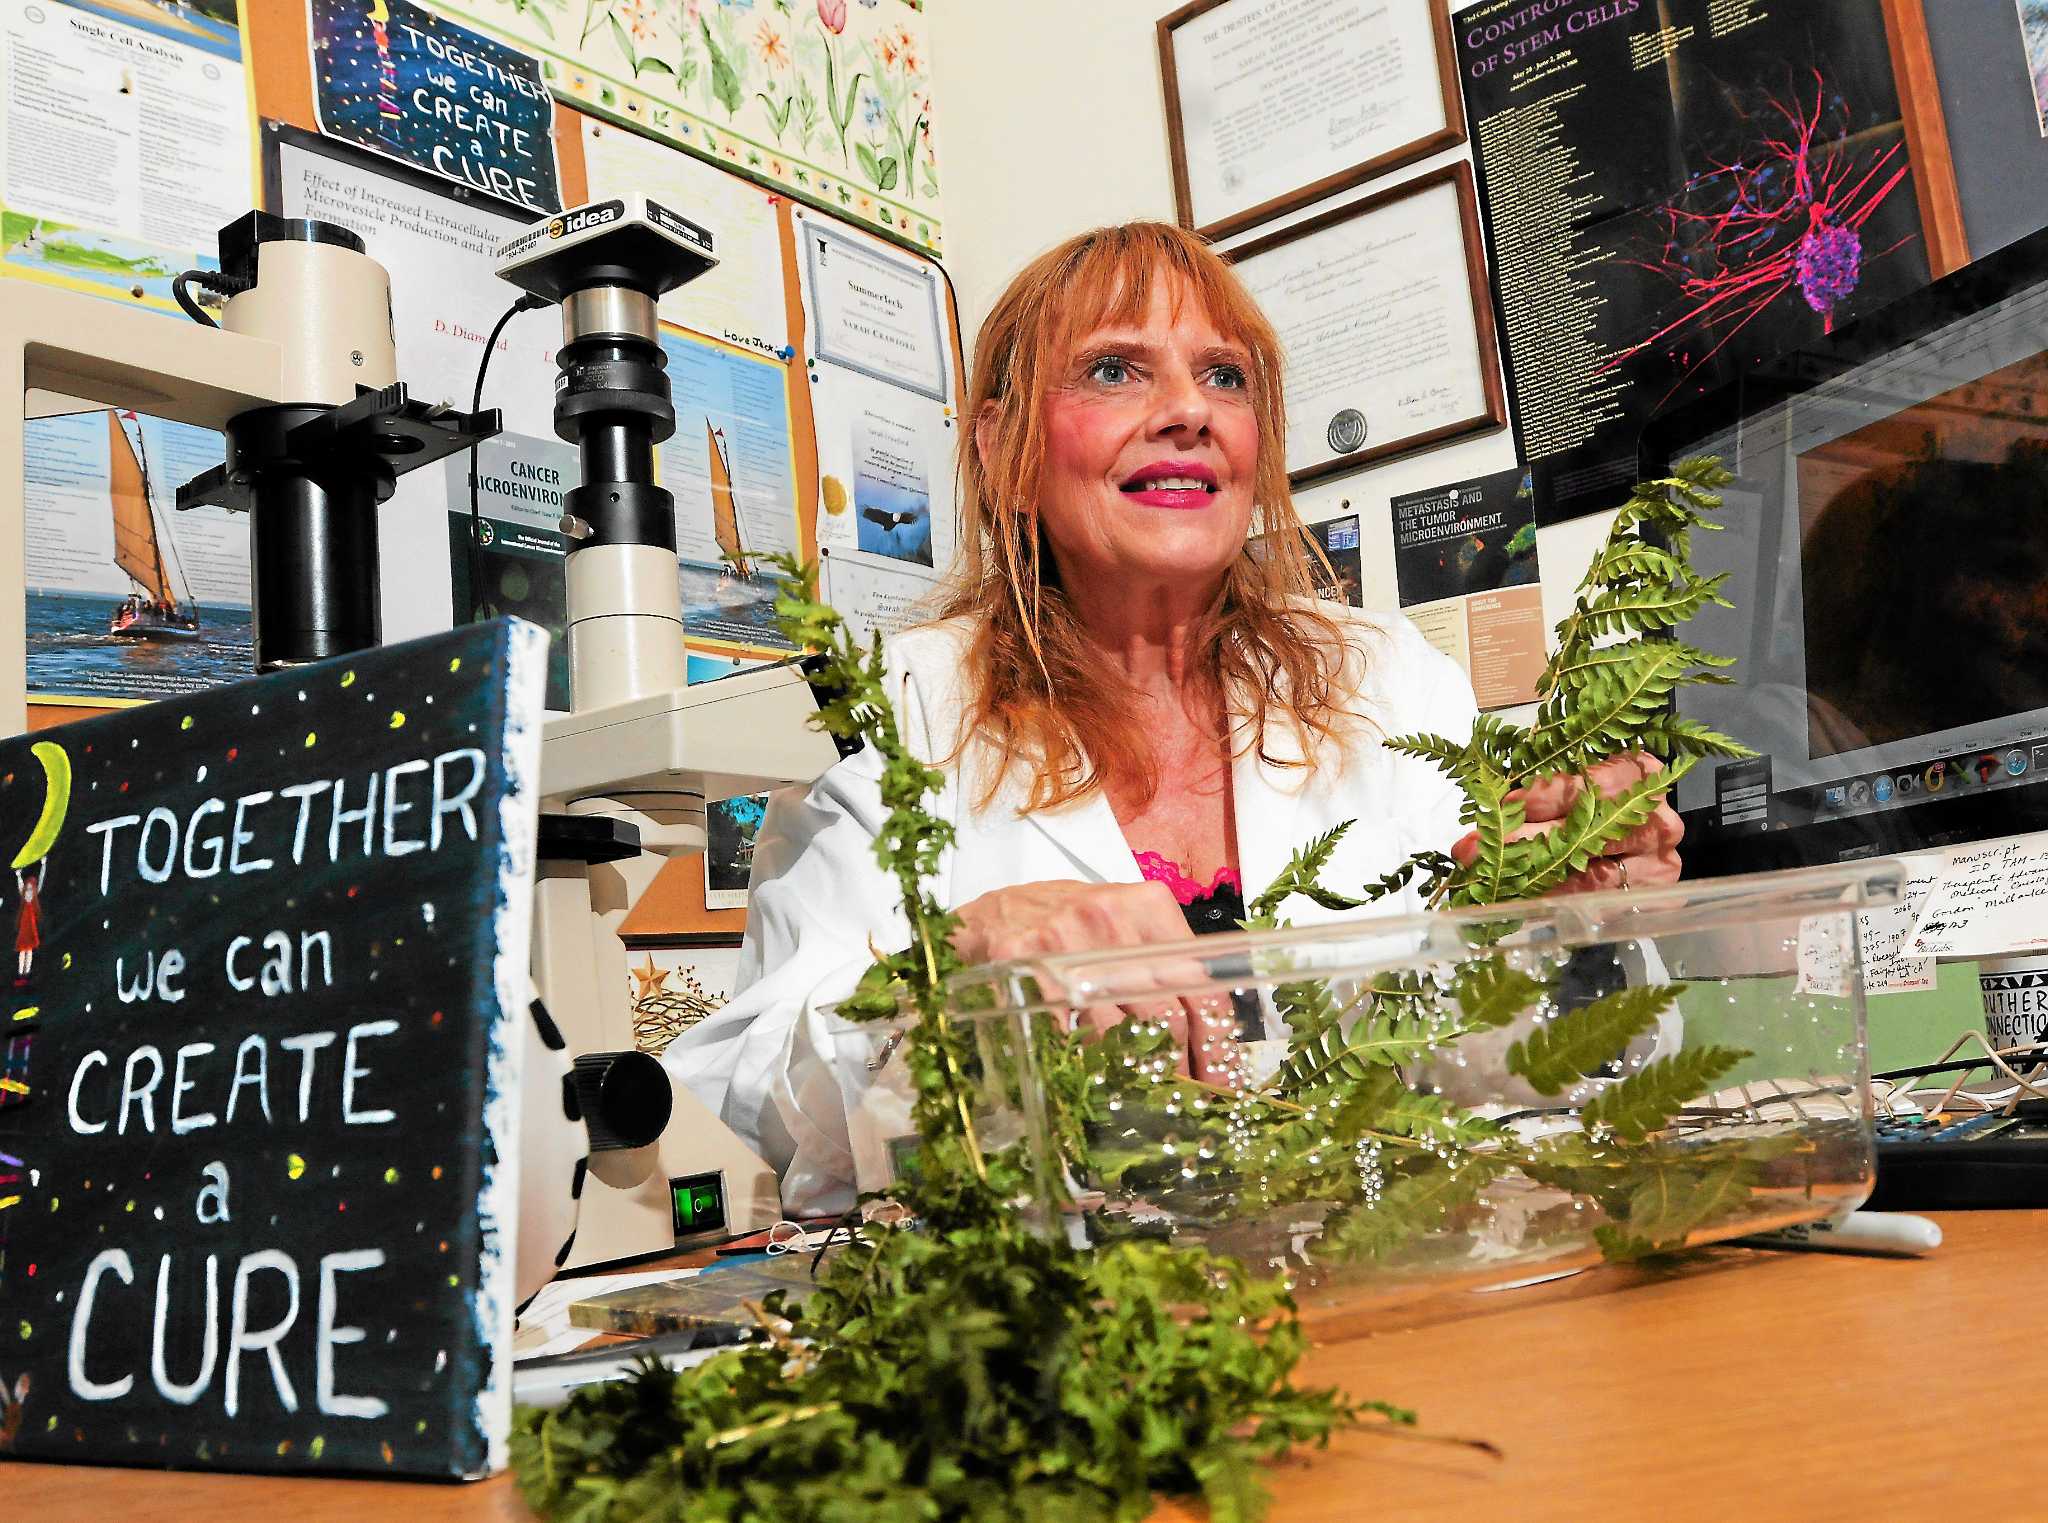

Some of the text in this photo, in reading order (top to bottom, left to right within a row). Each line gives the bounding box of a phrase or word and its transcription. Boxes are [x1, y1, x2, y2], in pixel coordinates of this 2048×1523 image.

[70, 18, 105, 38] Single
[110, 33, 133, 47] Cell
[139, 41, 184, 64] Analysis
[400, 24, 549, 104] TOGETHER
[1471, 0, 1640, 78] OF STEM CELLS
[412, 88, 533, 158] CREATE
[426, 67, 508, 117] we can
[432, 145, 547, 213] CURE
[470, 138, 484, 158] a
[303, 169, 500, 244] Effect of Increased Extracellular
[303, 186, 386, 223] Microvesicle
[390, 213, 458, 246] Production
[460, 239, 485, 256] and
[304, 203, 377, 237] Formation
[566, 208, 615, 234] idea
[510, 461, 560, 486] CANCER
[1398, 498, 1459, 519] METASTASIS
[1462, 490, 1483, 506] AND
[1400, 510, 1456, 532] THE TUMOR
[1400, 512, 1503, 545] MICROENVIRONMENT
[86, 747, 487, 897] TOGETHER
[116, 929, 335, 1003] we can
[68, 1019, 400, 1136] CREATE
[195, 1160, 231, 1225] a
[67, 1247, 390, 1419] CURE
